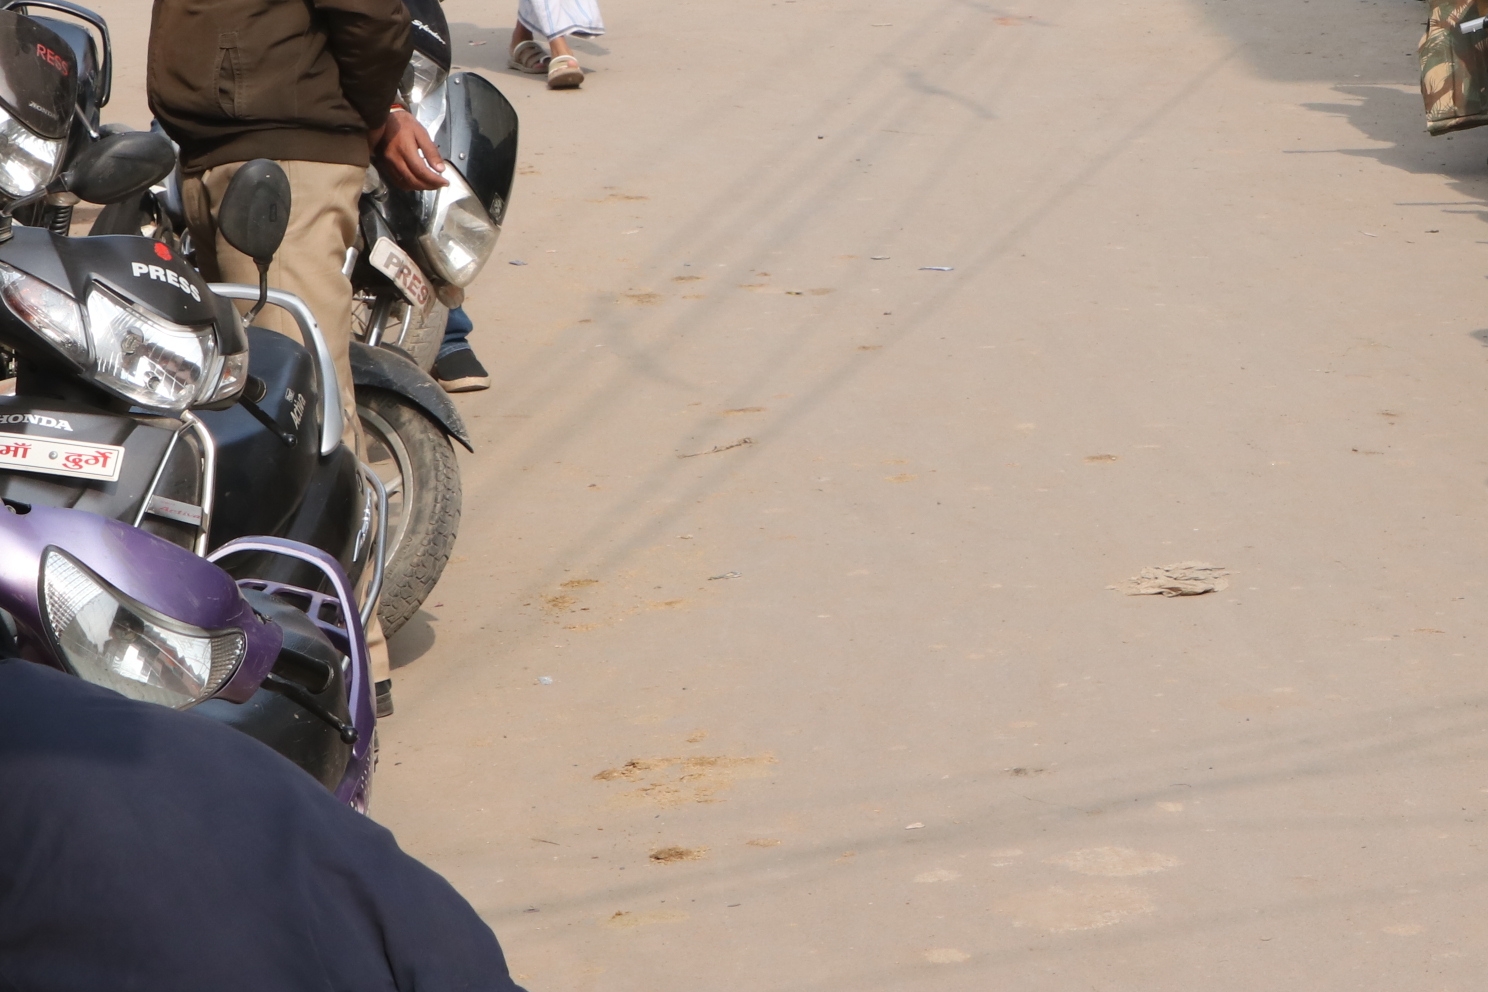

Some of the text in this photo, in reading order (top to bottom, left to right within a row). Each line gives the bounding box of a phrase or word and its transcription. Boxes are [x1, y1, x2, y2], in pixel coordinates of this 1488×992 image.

[131, 262, 201, 302] PRESS
[0, 414, 74, 432] HONDA
[62, 450, 114, 471] दुर्गे
